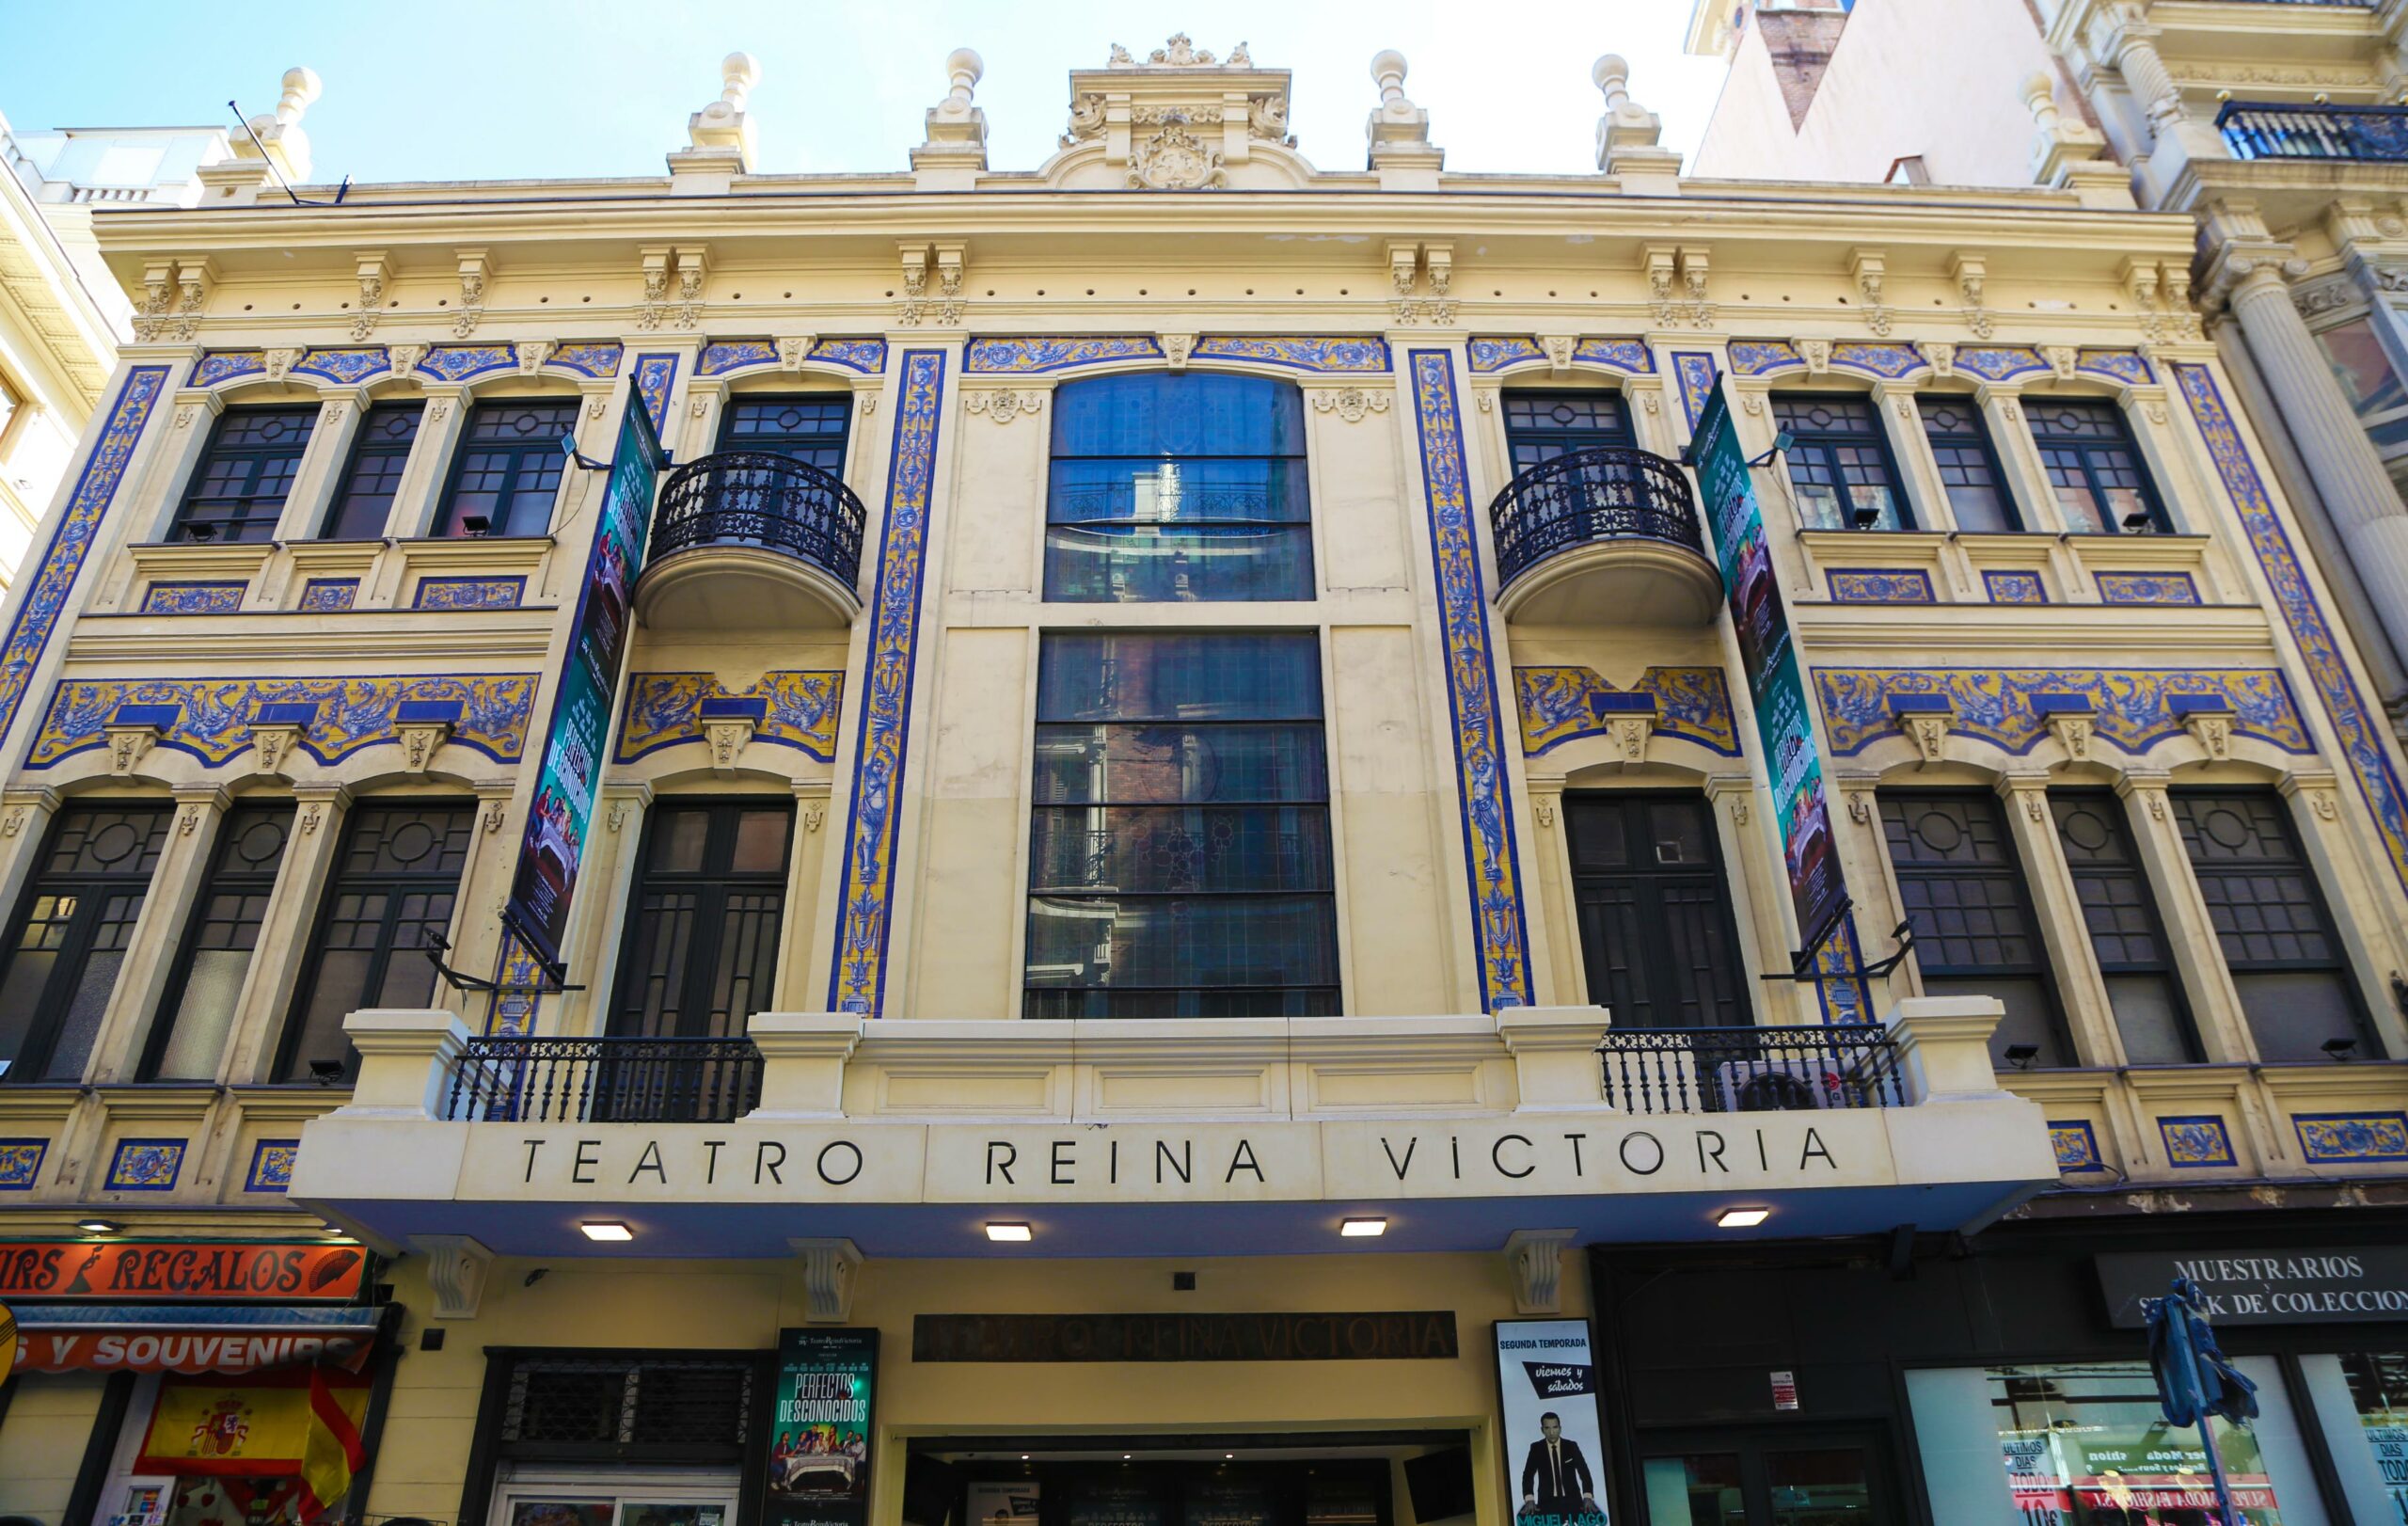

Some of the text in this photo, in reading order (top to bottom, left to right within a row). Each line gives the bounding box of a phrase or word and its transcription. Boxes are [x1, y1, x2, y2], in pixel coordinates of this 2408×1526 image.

[523, 1127, 1837, 1185] TEATRO REINA VICTORIA
[107, 1248, 307, 1292] REGALOS
[2174, 1256, 2364, 1282] MUESTRARIOS
[2232, 1294, 2268, 1314] DE
[1256, 1316, 1451, 1356] VICTORIA
[1499, 1338, 1587, 1350] SEGUNDA TEMPORADA
[51, 1336, 80, 1364] Y
[1535, 1365, 1583, 1378] viernes y
[795, 1373, 855, 1399] PERFECTOS
[779, 1399, 866, 1423] DESCONOCIDOS
[2003, 1441, 2043, 1454] ULTIMOS
[2380, 1444, 2402, 1454] DIAS
[2016, 1455, 2037, 1467] DIAS
